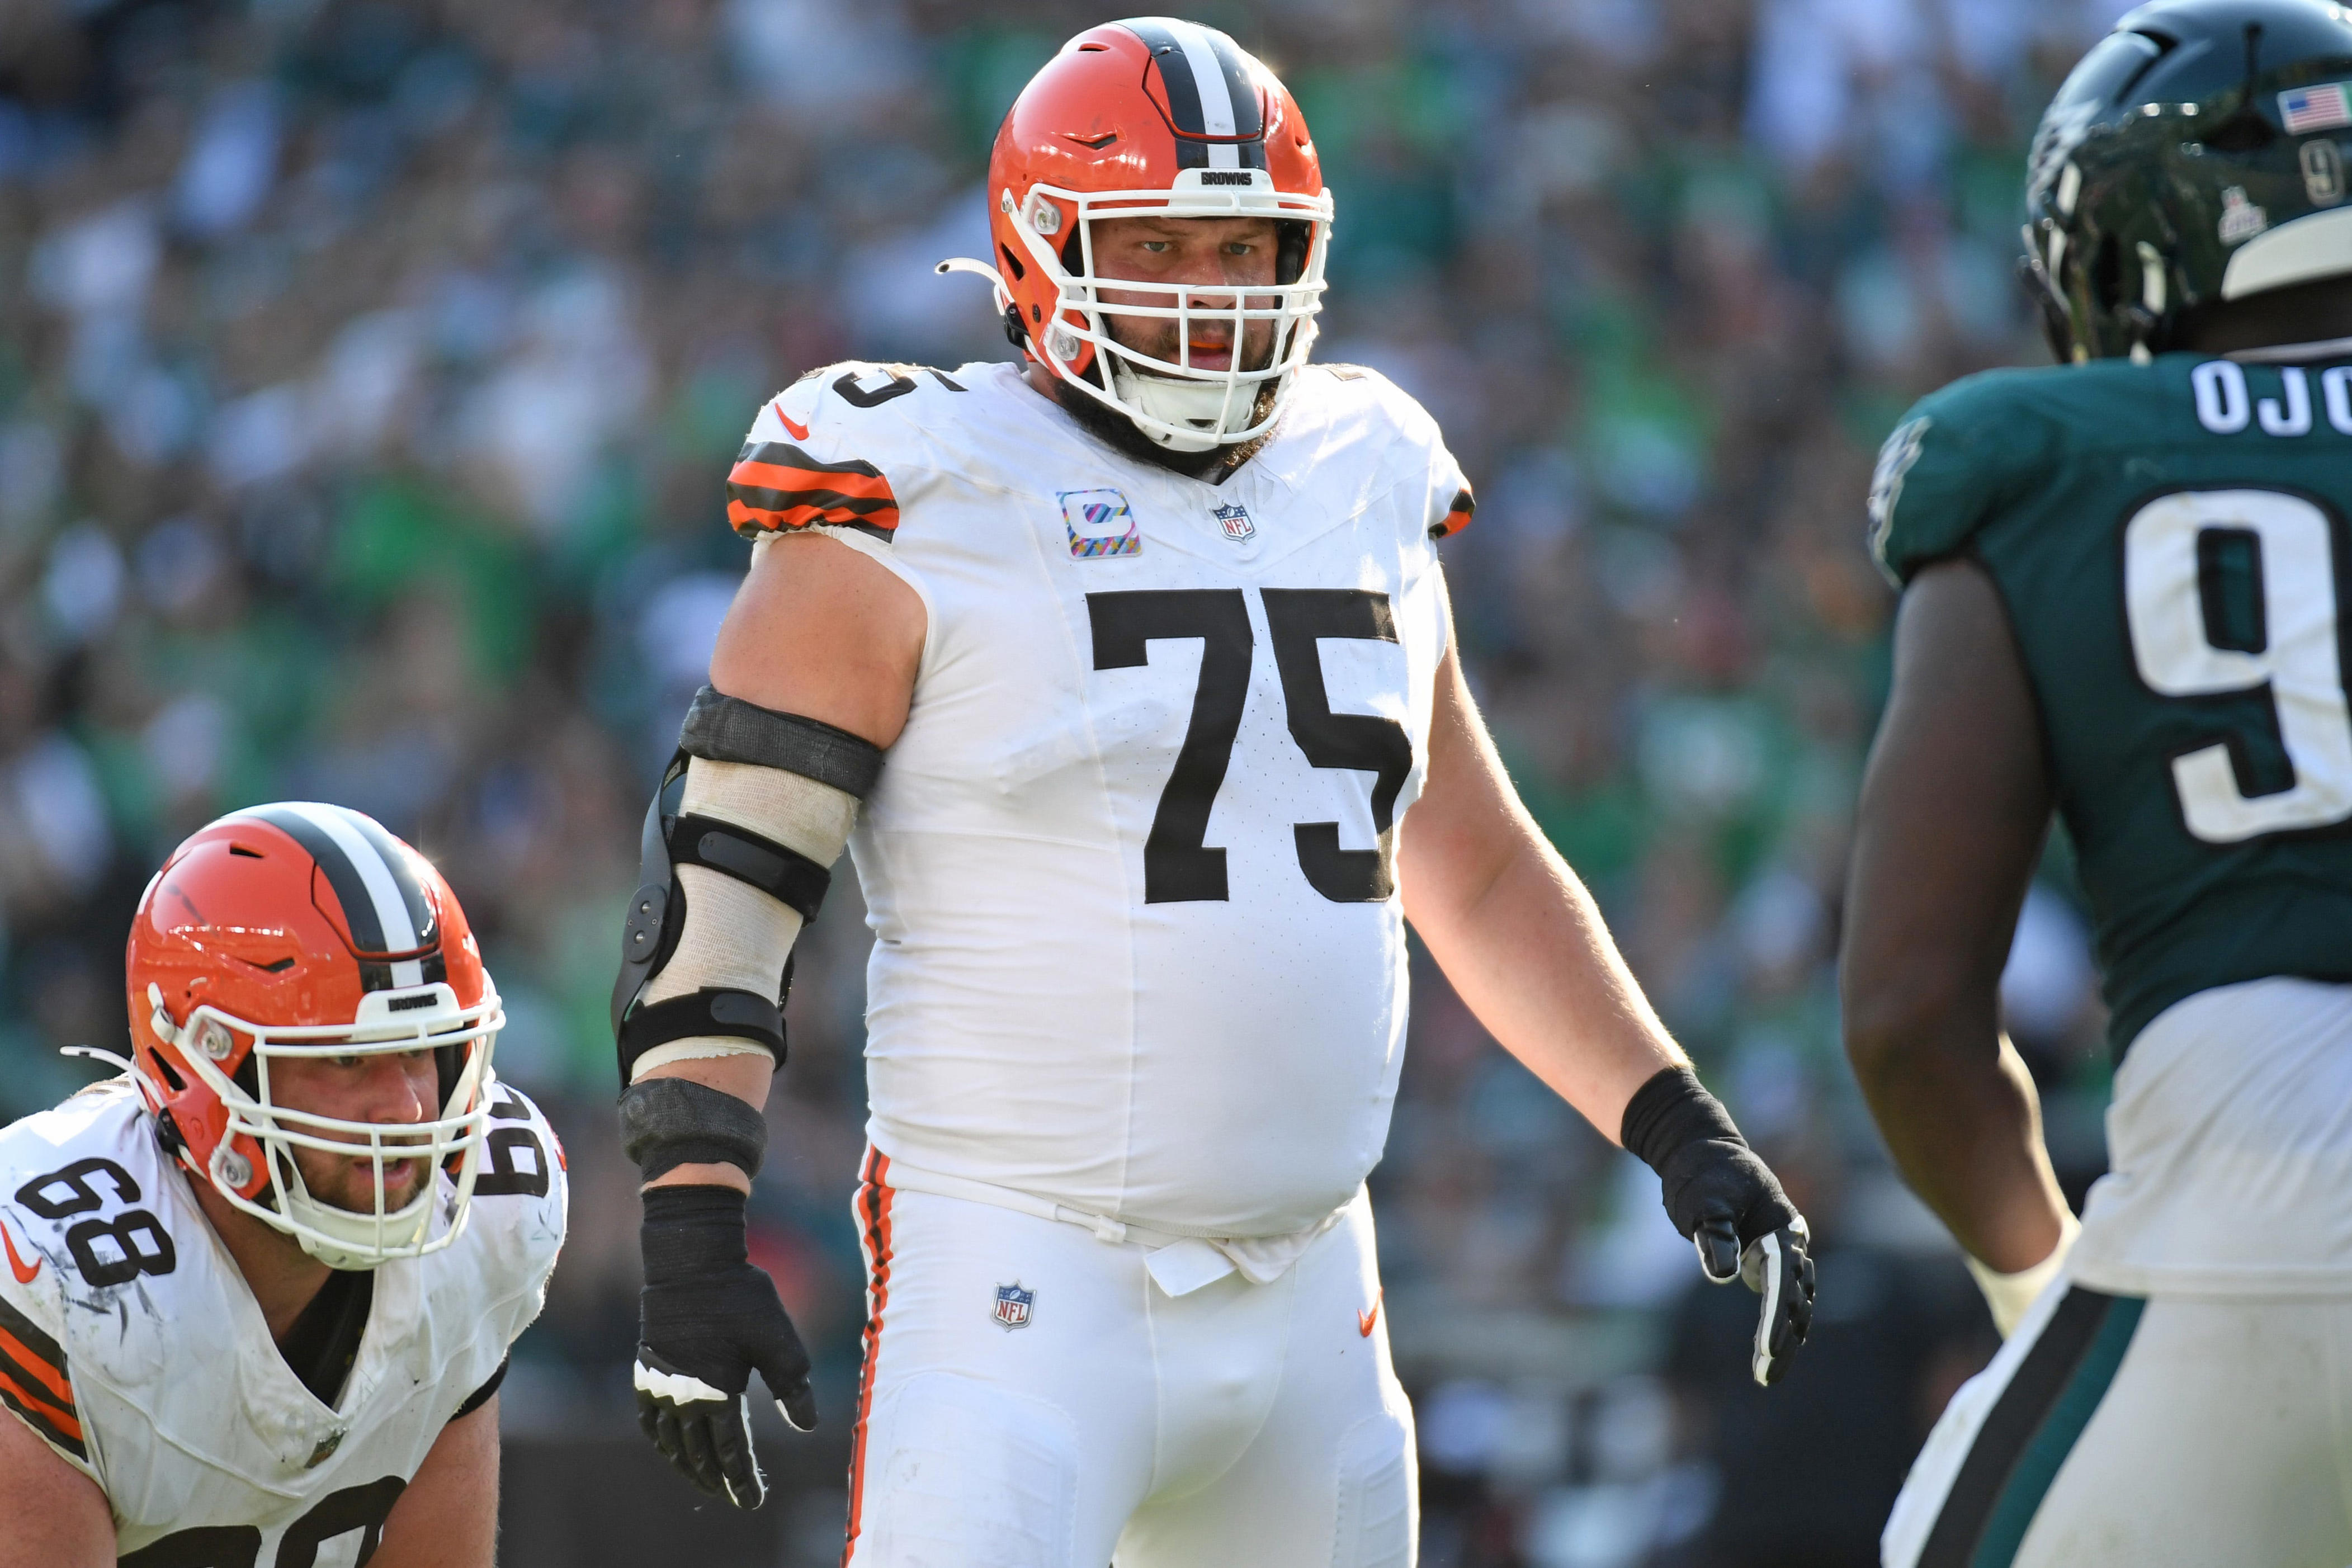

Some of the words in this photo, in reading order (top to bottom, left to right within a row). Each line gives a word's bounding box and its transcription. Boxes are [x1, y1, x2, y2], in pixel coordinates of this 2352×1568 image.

[1201, 172, 1252, 185] BROWNS
[1062, 492, 1132, 539] C
[1222, 518, 1252, 535] NFL
[2124, 488, 2352, 843] 9
[1085, 587, 1413, 904] 75
[15, 1156, 176, 1287] 68
[997, 1300, 1025, 1322] NFL
